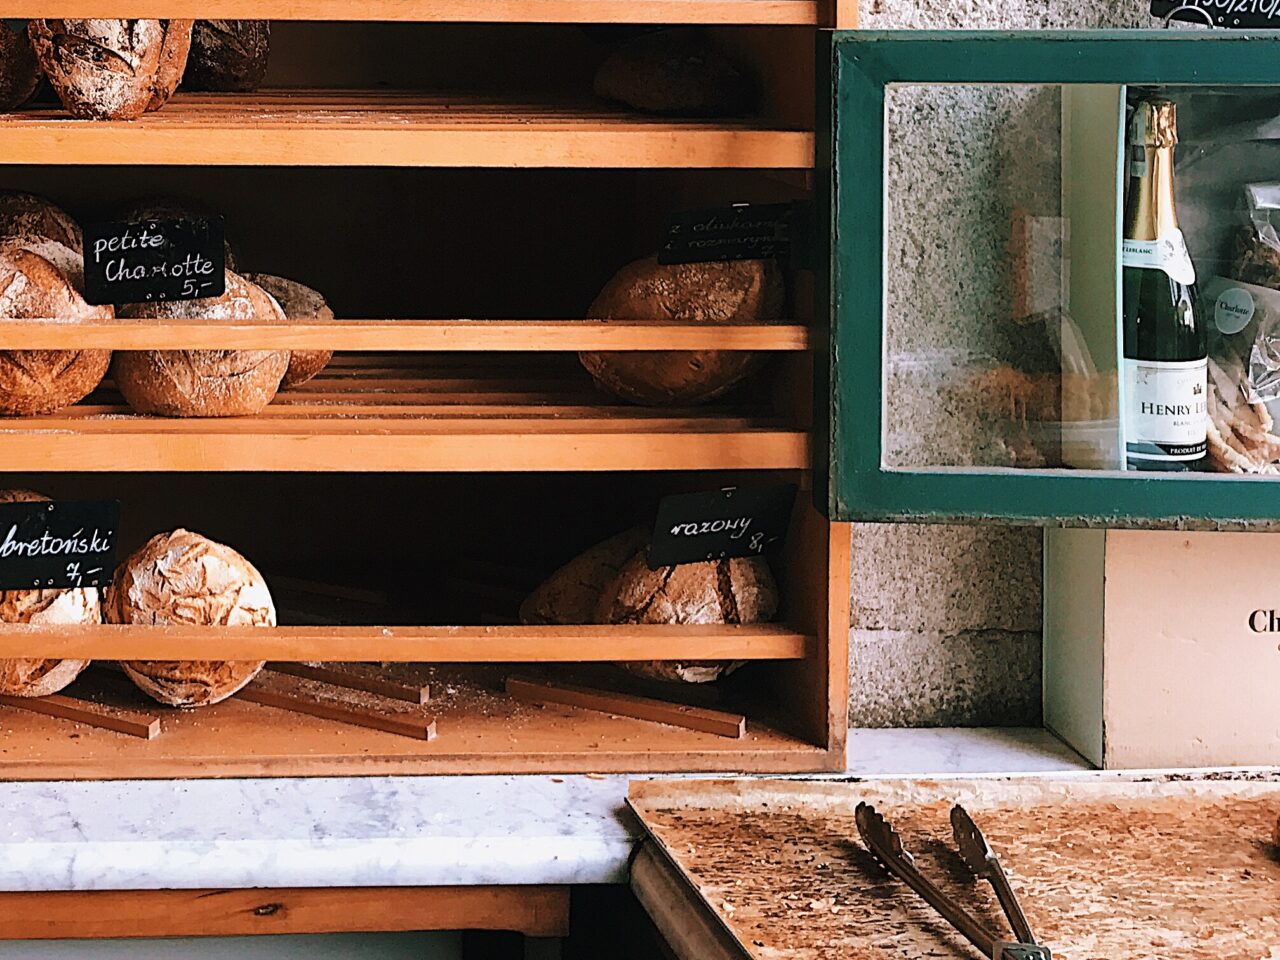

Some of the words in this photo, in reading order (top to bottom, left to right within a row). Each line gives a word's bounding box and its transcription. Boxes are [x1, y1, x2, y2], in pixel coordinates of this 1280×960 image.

[93, 229, 165, 263] petite
[105, 253, 215, 282] Charlotte
[1141, 401, 1192, 416] HENRY
[670, 517, 753, 539] razowy
